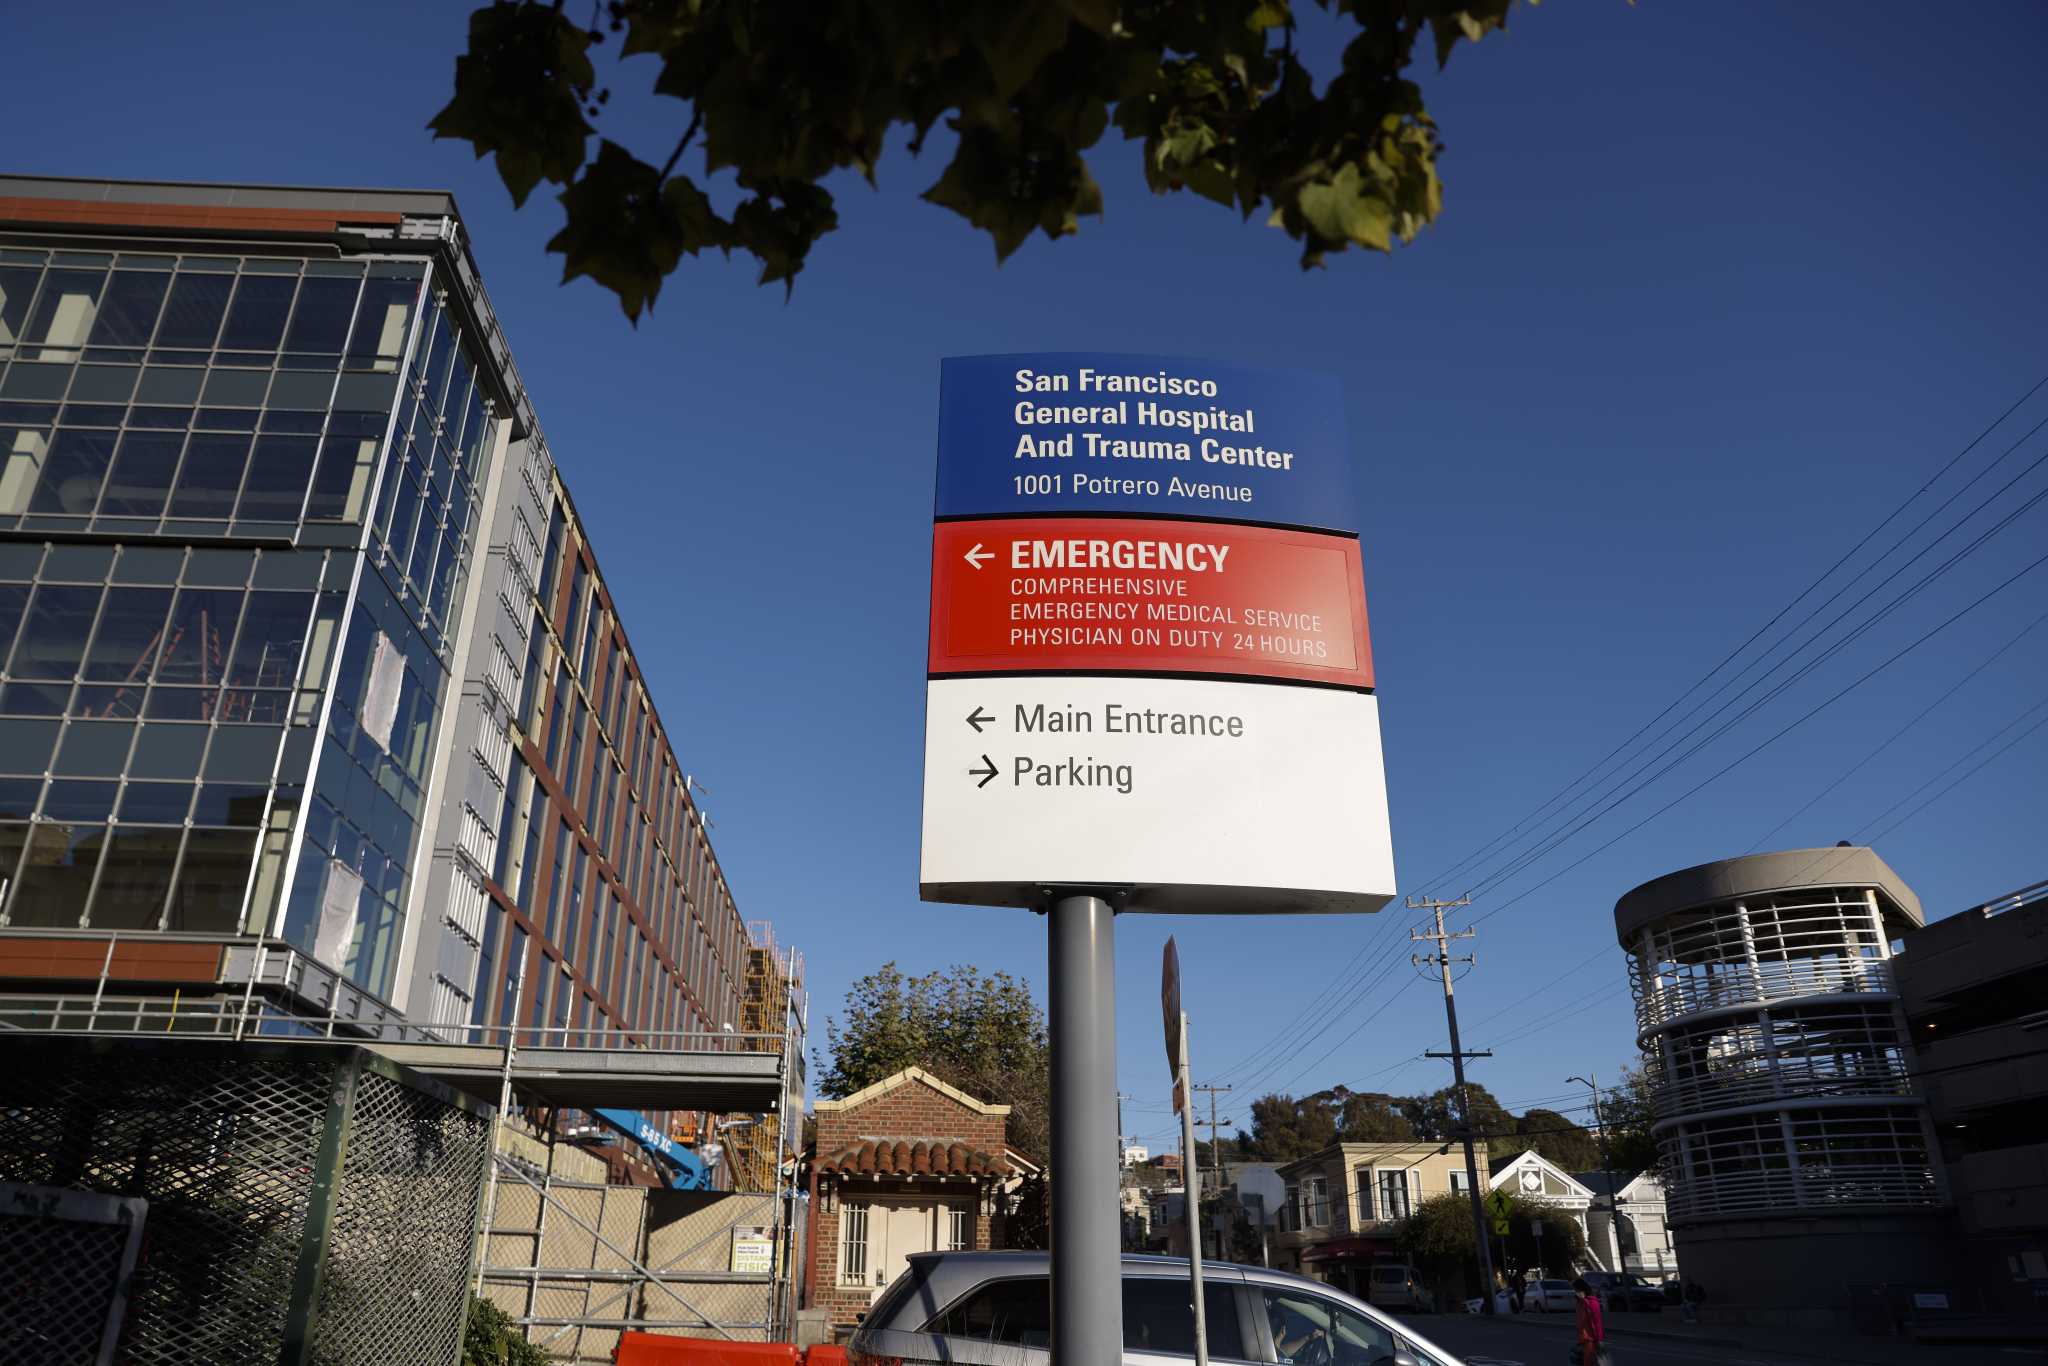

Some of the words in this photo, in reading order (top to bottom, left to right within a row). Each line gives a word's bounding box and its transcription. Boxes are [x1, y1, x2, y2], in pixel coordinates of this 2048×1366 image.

[1016, 370, 1068, 392] San
[1080, 369, 1217, 397] Francisco
[1015, 402, 1126, 424] General
[1138, 402, 1253, 434] Hospital
[1015, 433, 1072, 458] And
[1083, 434, 1190, 460] Trauma
[1201, 439, 1293, 470] Center
[1015, 475, 1060, 494] 1001
[1074, 474, 1159, 495] Potrero
[1168, 477, 1251, 502] Avenue
[1012, 540, 1229, 572] EMERGENCY
[1012, 578, 1187, 596] COMPREHENSIVE
[1011, 603, 1138, 619] EMERGENCY
[1148, 604, 1237, 623] MEDICAL
[1244, 608, 1322, 632] SERVICE
[1011, 628, 1121, 645] PHYSICIAN
[1132, 628, 1160, 645] ON
[1170, 630, 1223, 648] DUTY
[1233, 634, 1255, 650] 24
[1260, 635, 1327, 657] HOURS
[1016, 704, 1091, 732] Main
[1106, 704, 1242, 737] Entrance
[1014, 757, 1132, 793] Parking
[659, 1136, 672, 1153] XC
